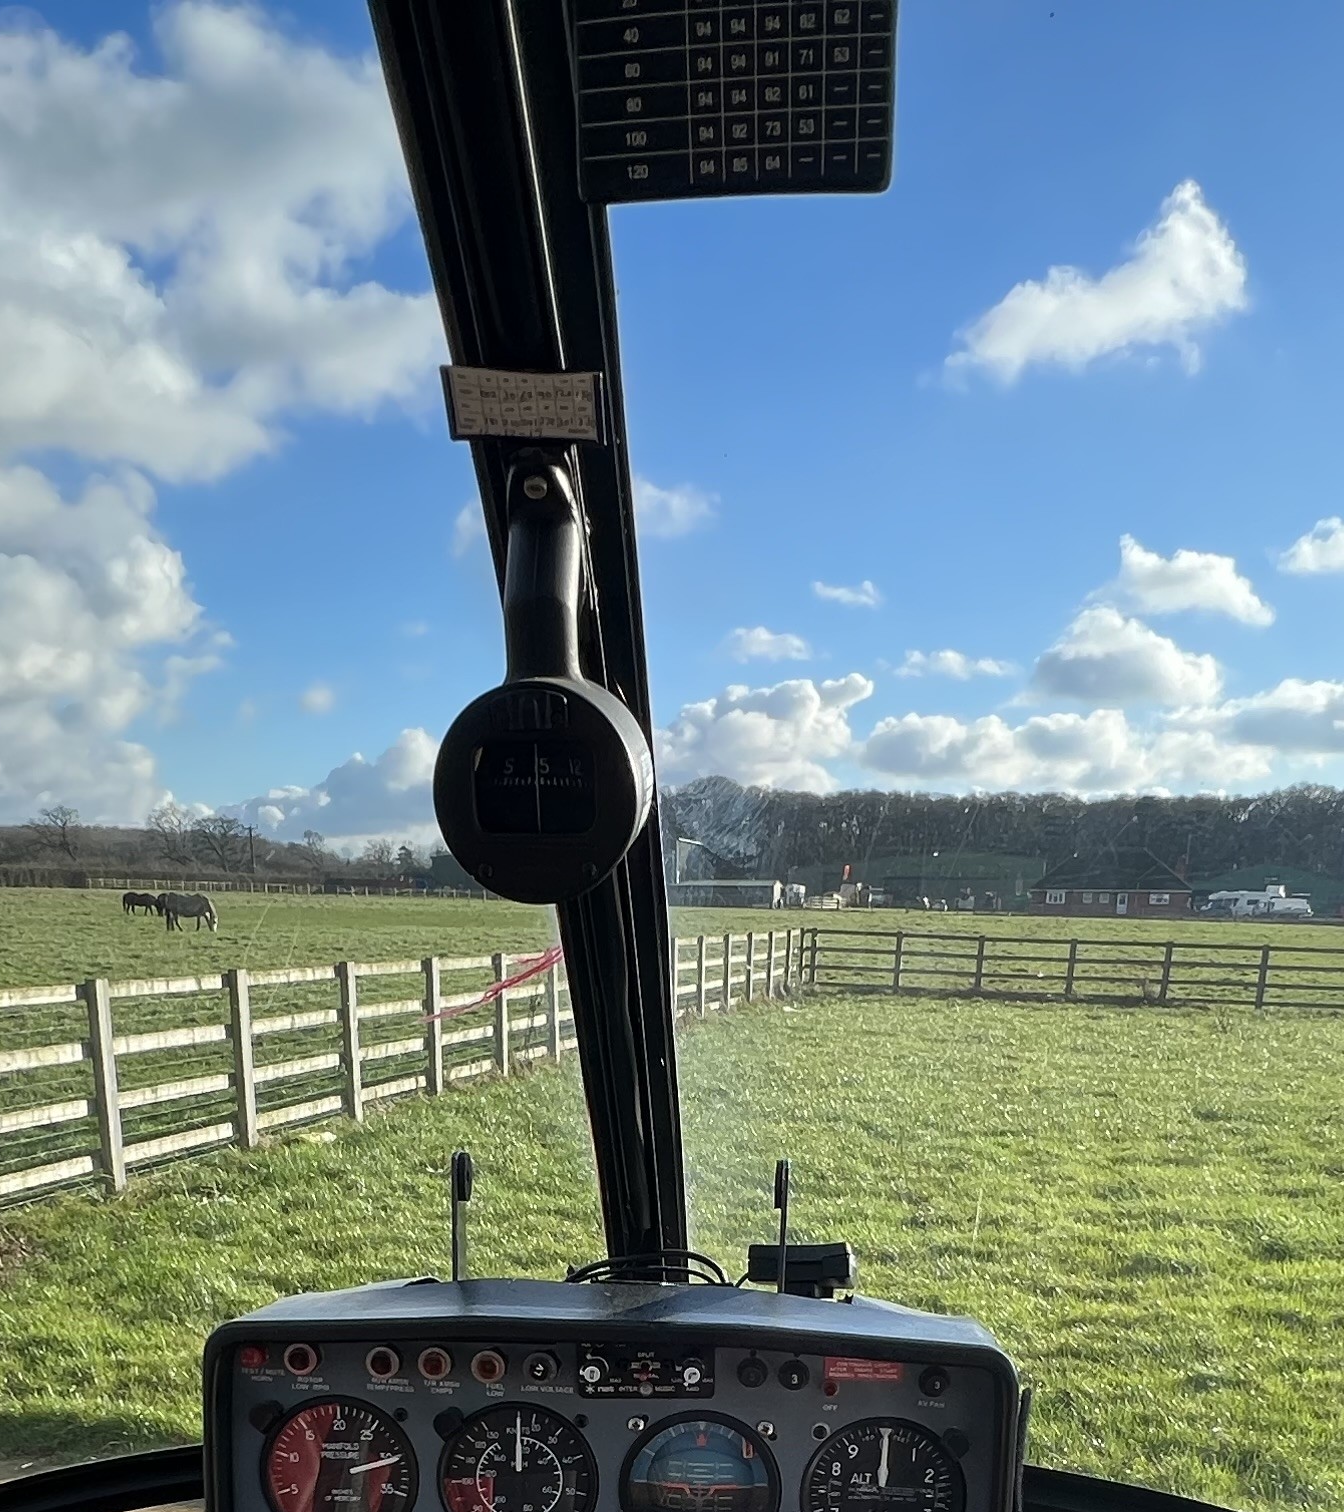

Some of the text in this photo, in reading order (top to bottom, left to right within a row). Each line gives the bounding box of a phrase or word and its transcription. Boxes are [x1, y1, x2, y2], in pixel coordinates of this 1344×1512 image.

[800, 48, 814, 64] 71
[625, 131, 647, 147] 100
[766, 121, 781, 136] 73
[333, 1420, 346, 1430] 20
[360, 1430, 373, 1440] 25
[848, 1445, 859, 1459] 9
[912, 1447, 916, 1462] 1
[831, 1462, 841, 1476] 8
[924, 1469, 934, 1483] 2
[850, 1473, 872, 1484] ALT
[291, 1484, 298, 1494] 5
[380, 1484, 394, 1494] 35
